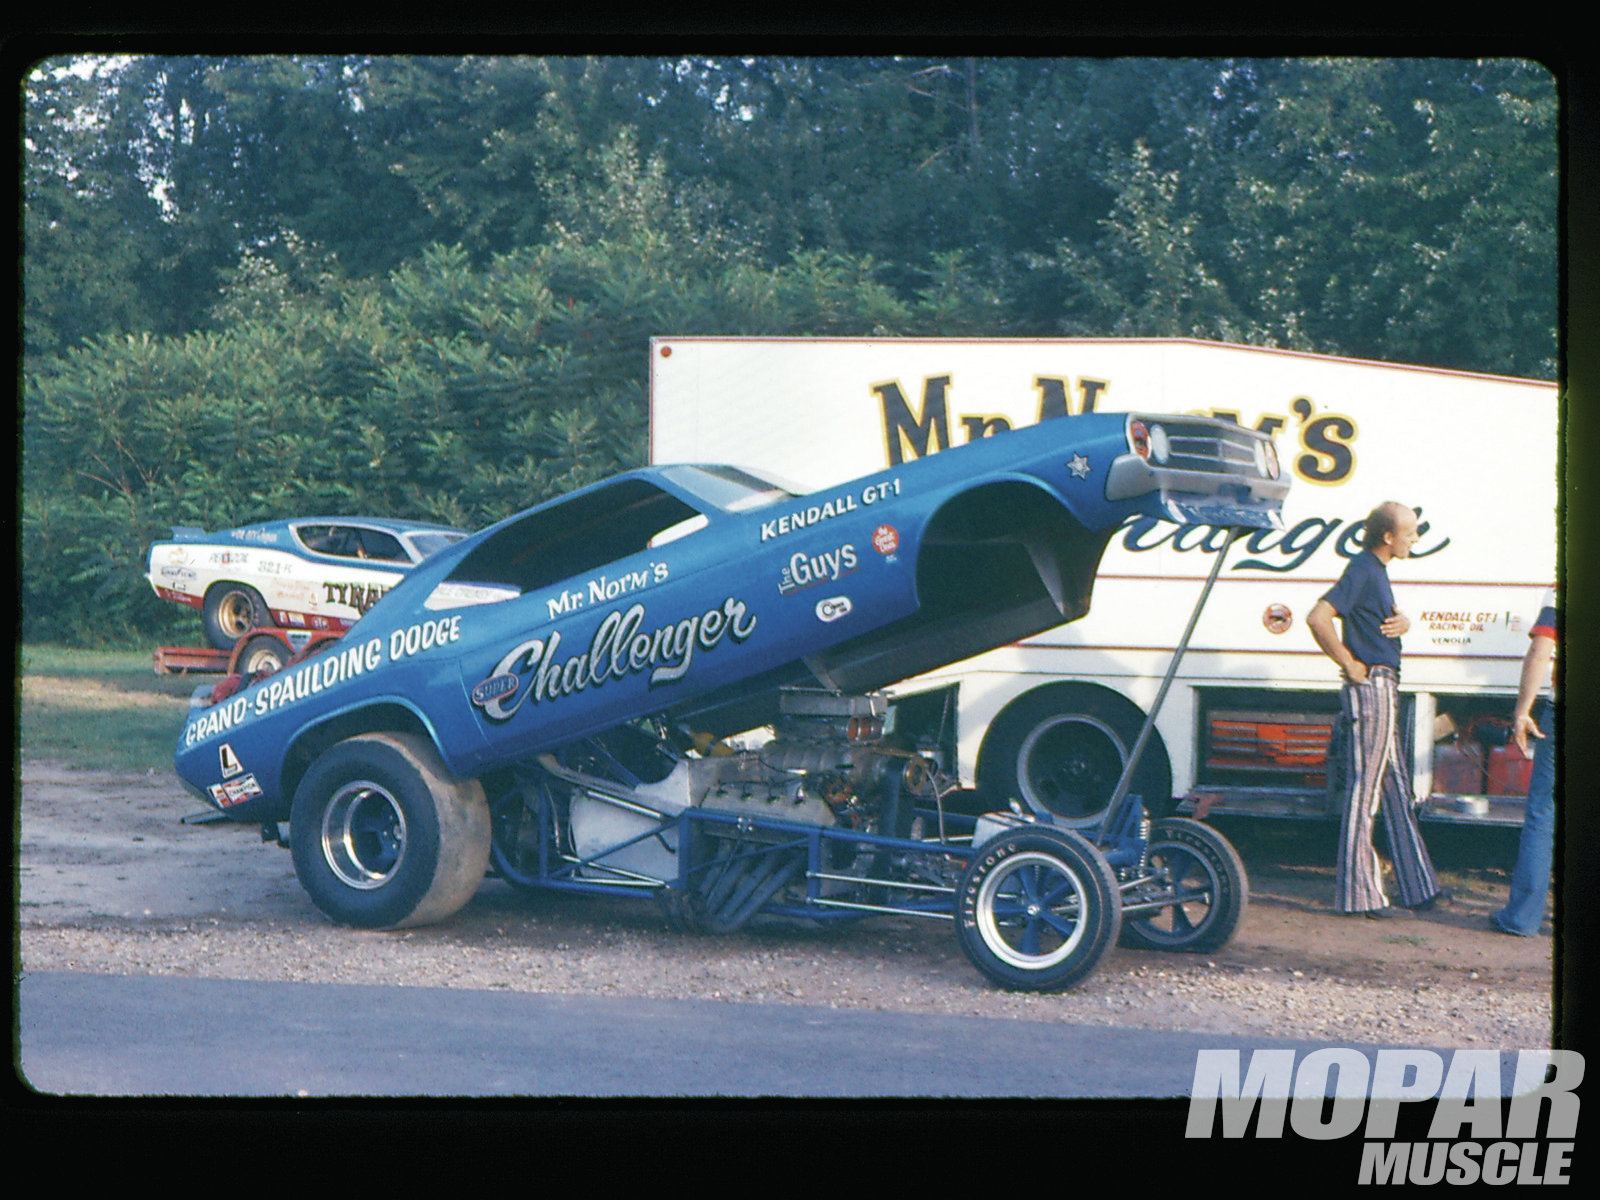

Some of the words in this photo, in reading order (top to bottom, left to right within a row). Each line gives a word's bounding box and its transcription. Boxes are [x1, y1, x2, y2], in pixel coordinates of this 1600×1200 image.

[761, 494, 858, 541] KENDALL
[862, 478, 901, 505] GT-1
[790, 544, 858, 585] Guys
[546, 590, 584, 620] Mr.
[1420, 611, 1472, 622] KENDALL
[389, 615, 463, 661] DODGE
[1429, 622, 1465, 632] RACING
[1469, 623, 1485, 632] OIL
[485, 598, 757, 719] Challenger
[475, 677, 516, 701] SUPER
